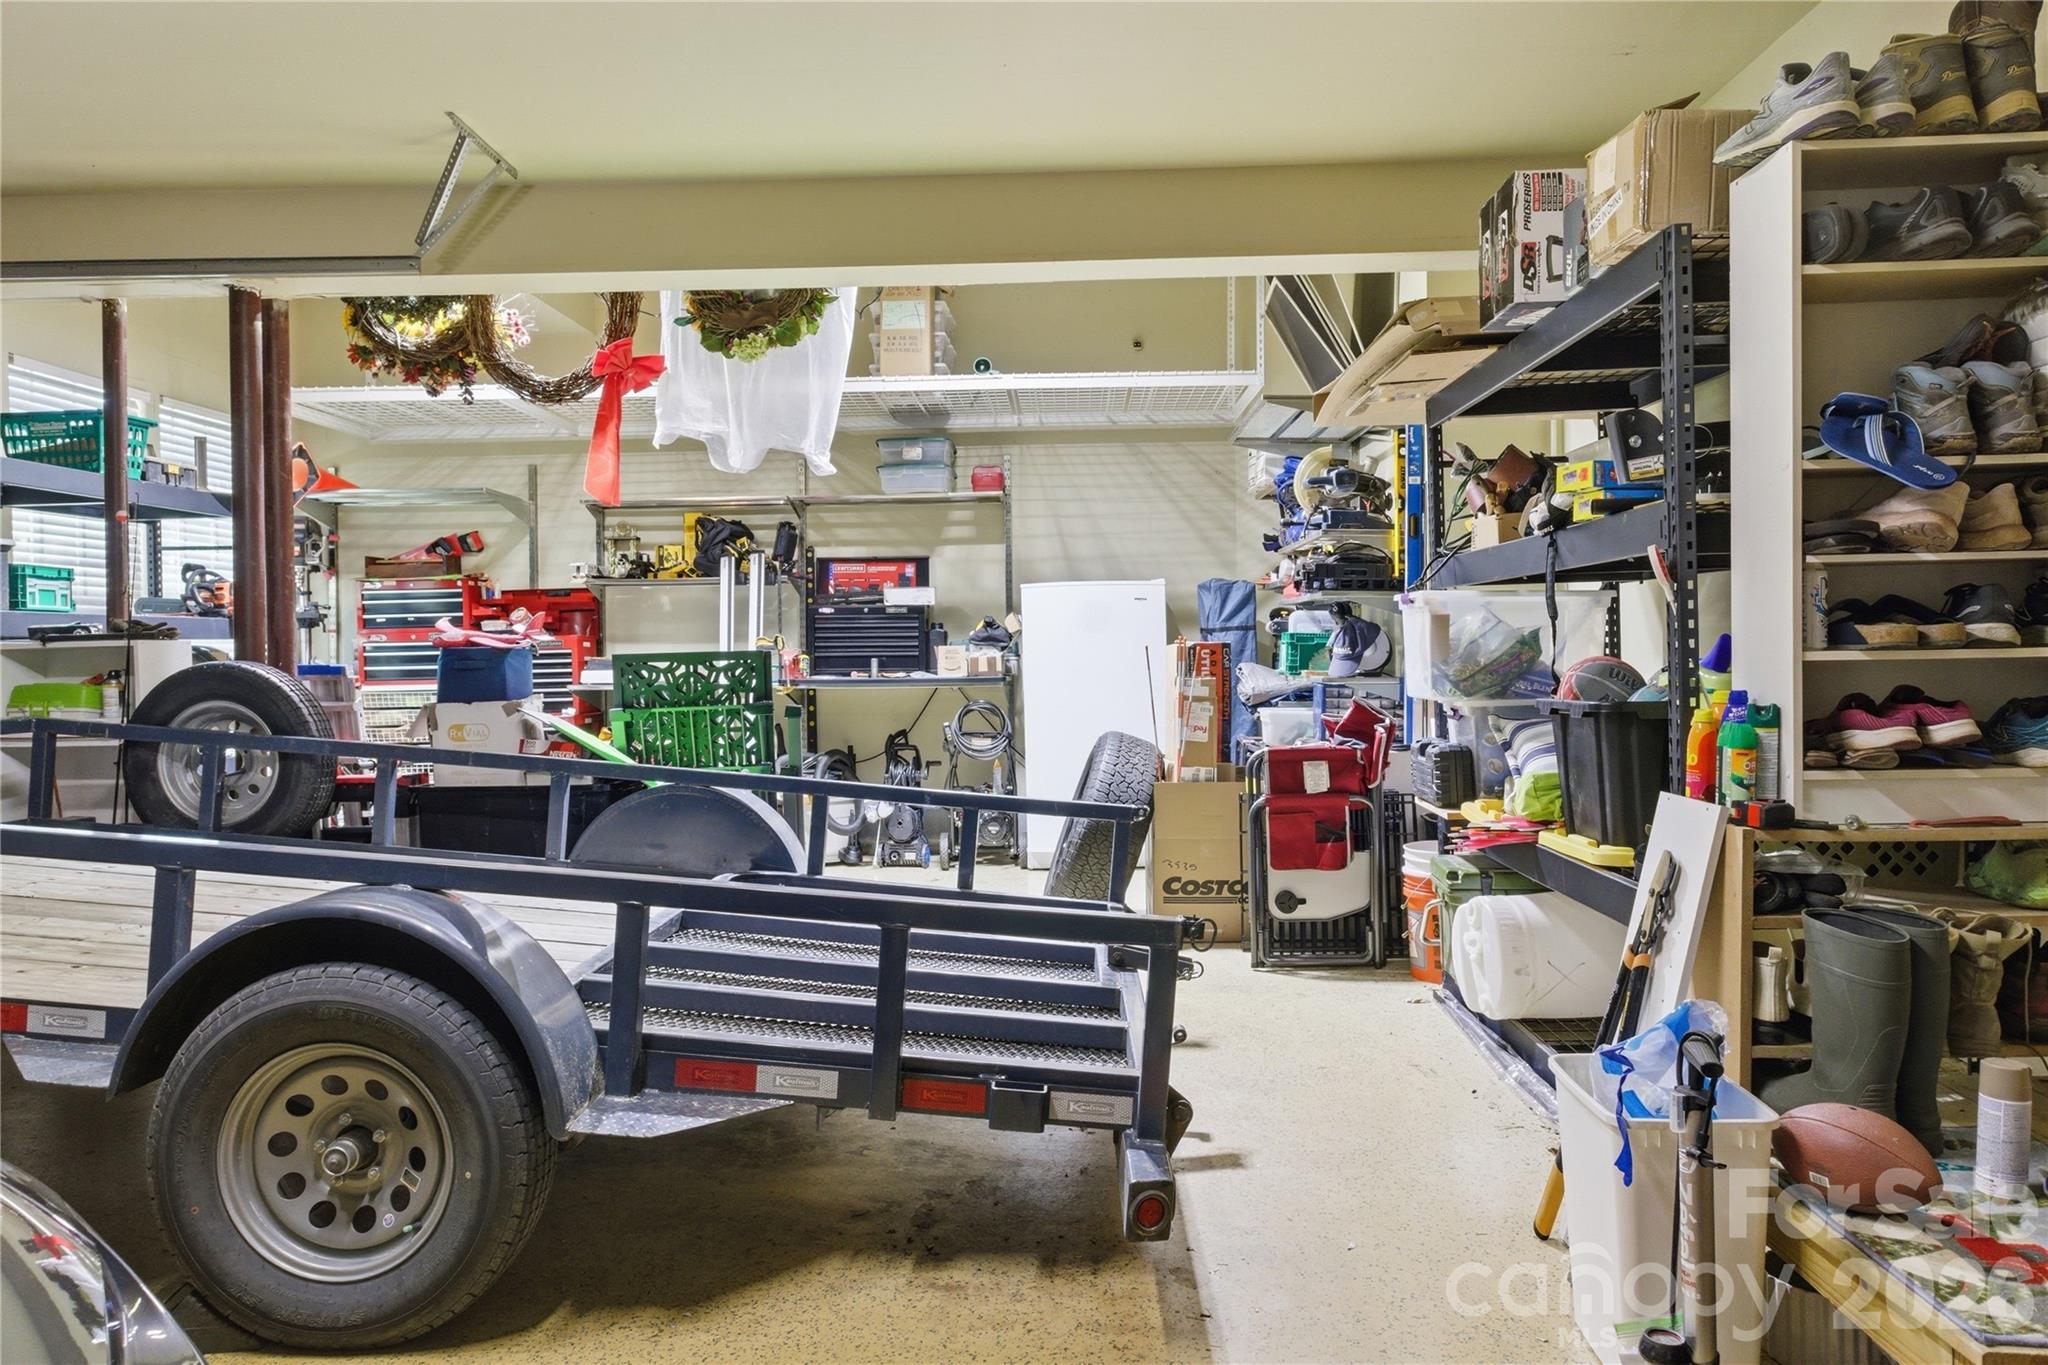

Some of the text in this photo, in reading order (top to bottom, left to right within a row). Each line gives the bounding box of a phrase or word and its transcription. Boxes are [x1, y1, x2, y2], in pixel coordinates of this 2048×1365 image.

[1522, 172, 1532, 231] PROSERIES
[1520, 243, 1537, 292] DSR
[1565, 248, 1573, 288] SKIL
